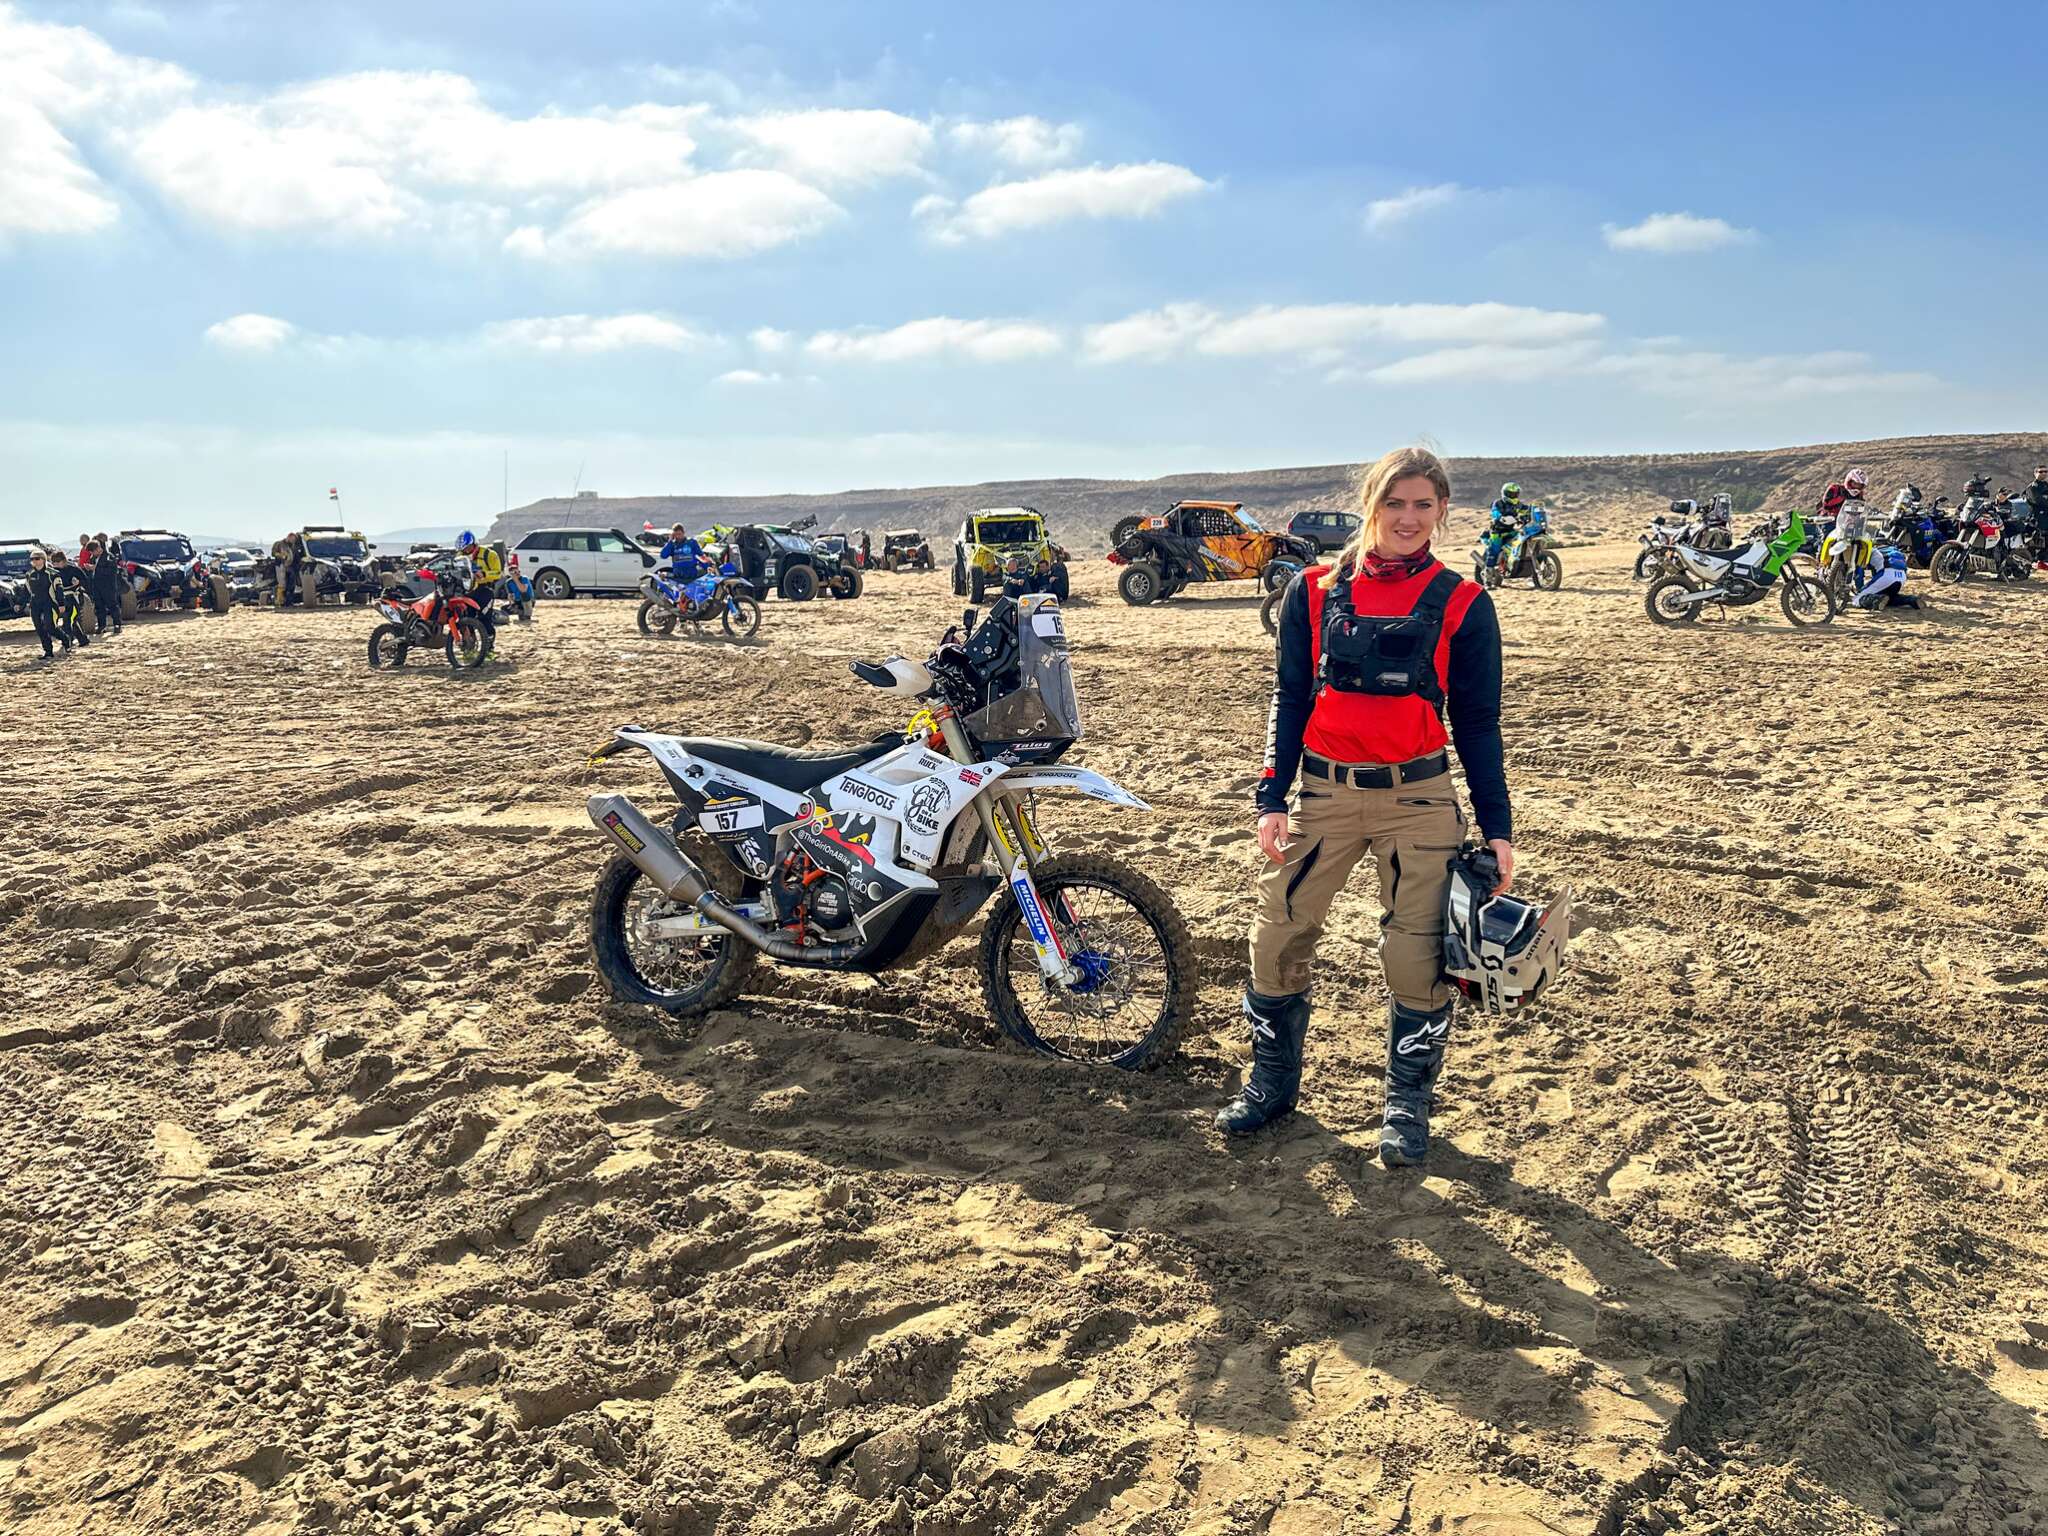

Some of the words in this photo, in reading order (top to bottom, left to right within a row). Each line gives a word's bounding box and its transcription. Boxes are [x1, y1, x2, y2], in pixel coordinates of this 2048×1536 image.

[839, 775, 898, 811] TENGTOOLS
[908, 784, 945, 818] Girl
[714, 811, 739, 831] 157
[916, 814, 939, 831] BIKE
[798, 830, 851, 867] @TheGirlOnABike
[911, 850, 932, 862] CTEK
[1019, 883, 1046, 935] MICHELIN
